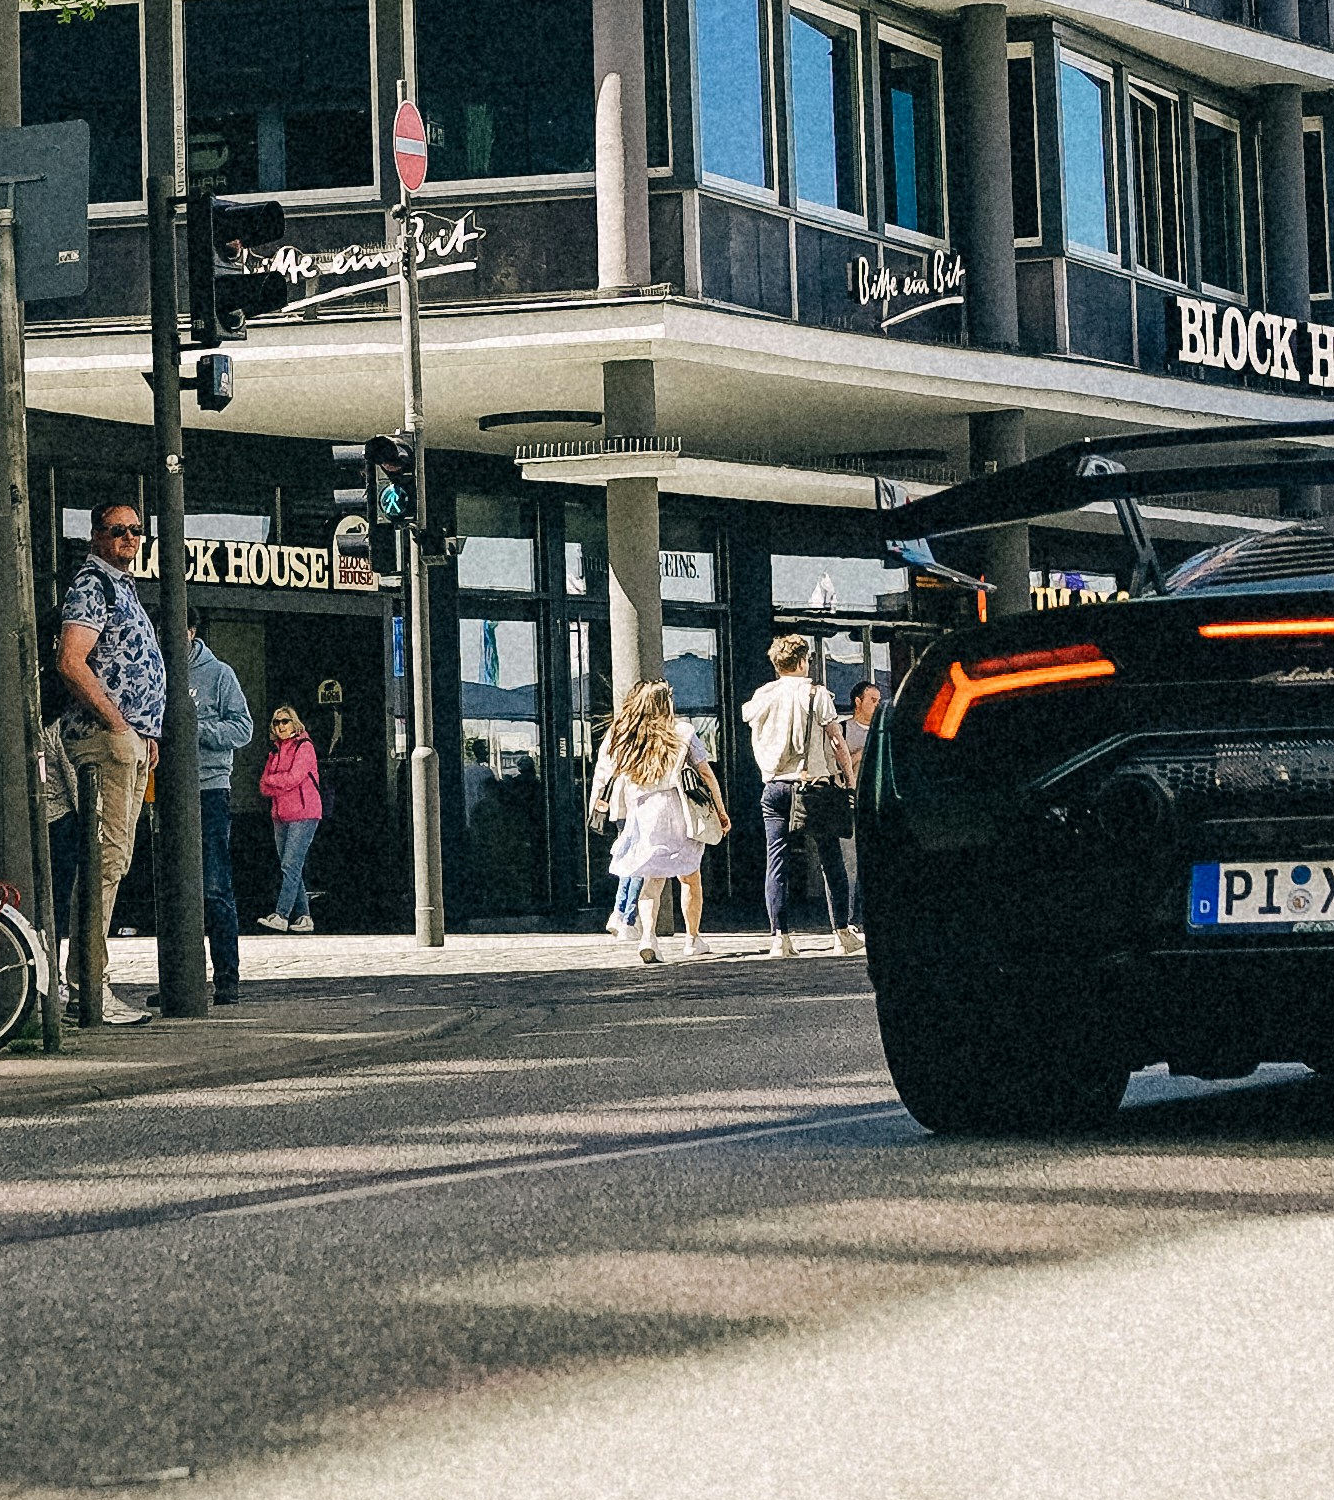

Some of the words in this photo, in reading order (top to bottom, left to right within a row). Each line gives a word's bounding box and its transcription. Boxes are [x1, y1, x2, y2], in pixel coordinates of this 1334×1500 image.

[858, 256, 898, 305] Bitte
[903, 270, 929, 295] ein
[934, 249, 966, 293] Bit
[1176, 295, 1301, 382] BLOCK
[224, 541, 329, 589] HOUSE
[338, 570, 374, 586] HOUSE
[1199, 900, 1211, 914] D
[1224, 869, 1281, 915] PI
